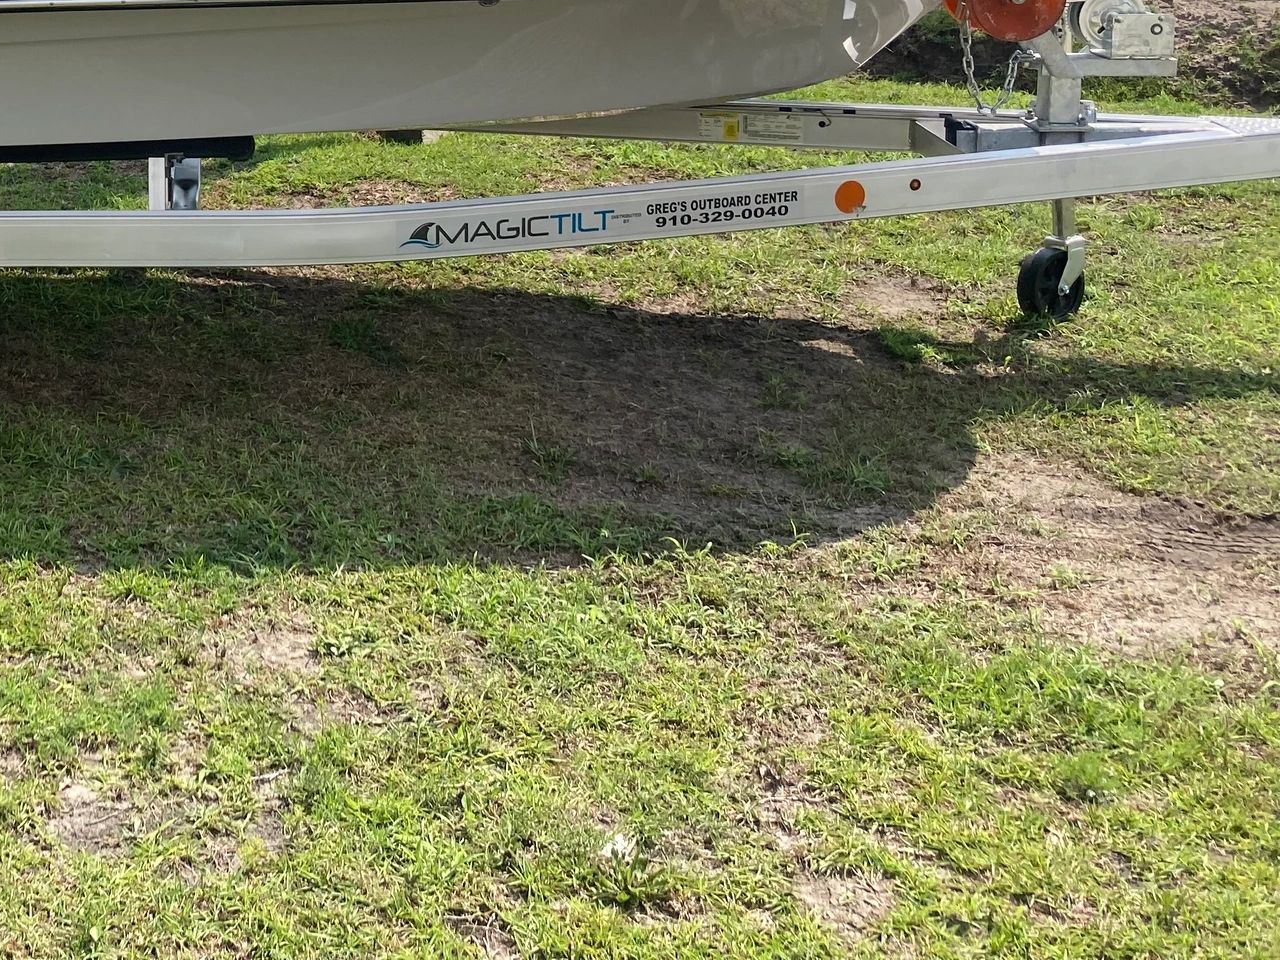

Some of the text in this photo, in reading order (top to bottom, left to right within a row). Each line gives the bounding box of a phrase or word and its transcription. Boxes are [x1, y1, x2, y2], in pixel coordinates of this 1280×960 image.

[646, 191, 798, 215] GREG'S OUTBOARD CENTER
[434, 209, 615, 245] MAGICTILT
[655, 205, 789, 228] 910-329-0040
